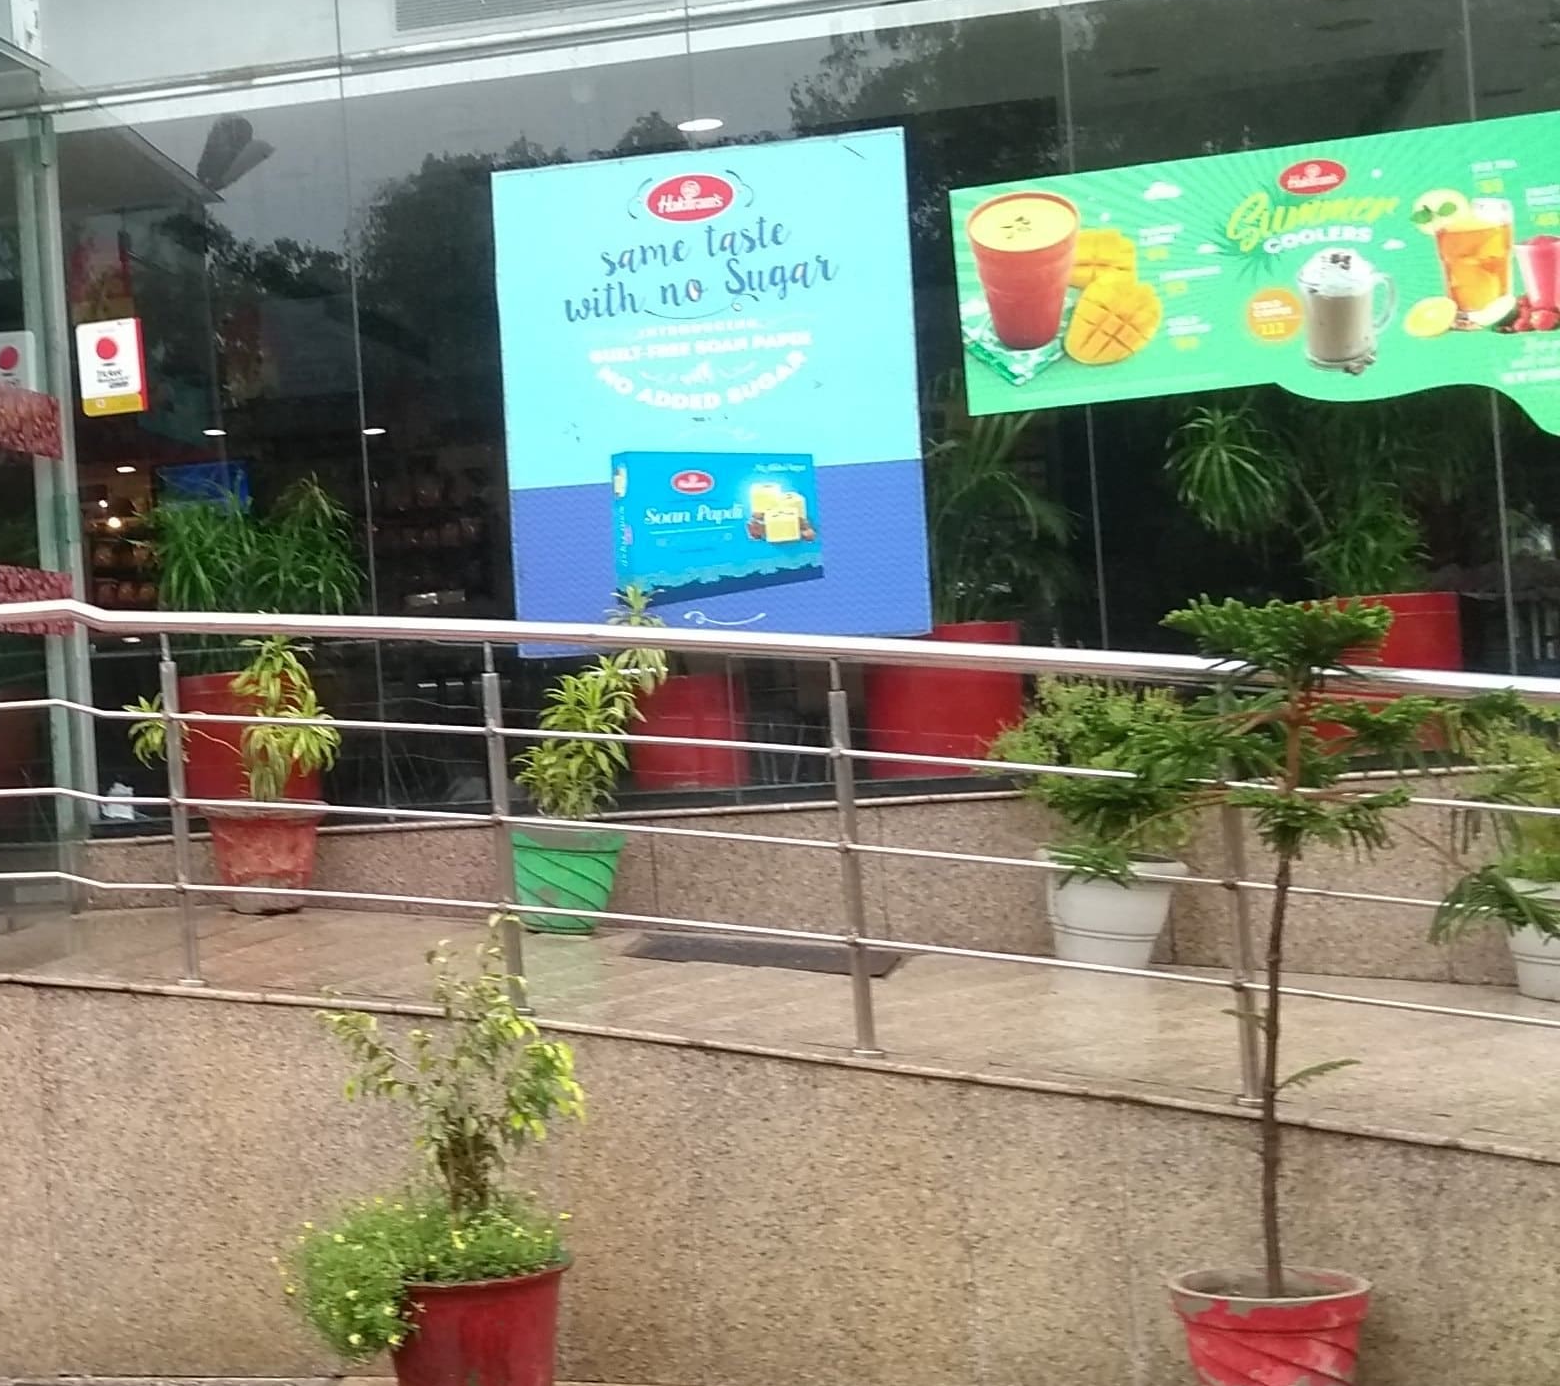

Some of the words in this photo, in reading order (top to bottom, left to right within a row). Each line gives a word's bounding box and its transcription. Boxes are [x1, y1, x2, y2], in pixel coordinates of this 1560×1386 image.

[601, 238, 691, 277] same
[704, 215, 792, 258] taste
[1226, 191, 1401, 254] Summer
[1263, 224, 1373, 255] COOLERS
[564, 281, 643, 323] with
[659, 278, 708, 307] no
[725, 254, 839, 300] Sugar
[596, 366, 635, 396] NO
[636, 387, 722, 410] ADDED
[727, 350, 807, 404] SUGAR
[644, 507, 690, 526] Soan
[696, 502, 744, 525] Papdi
